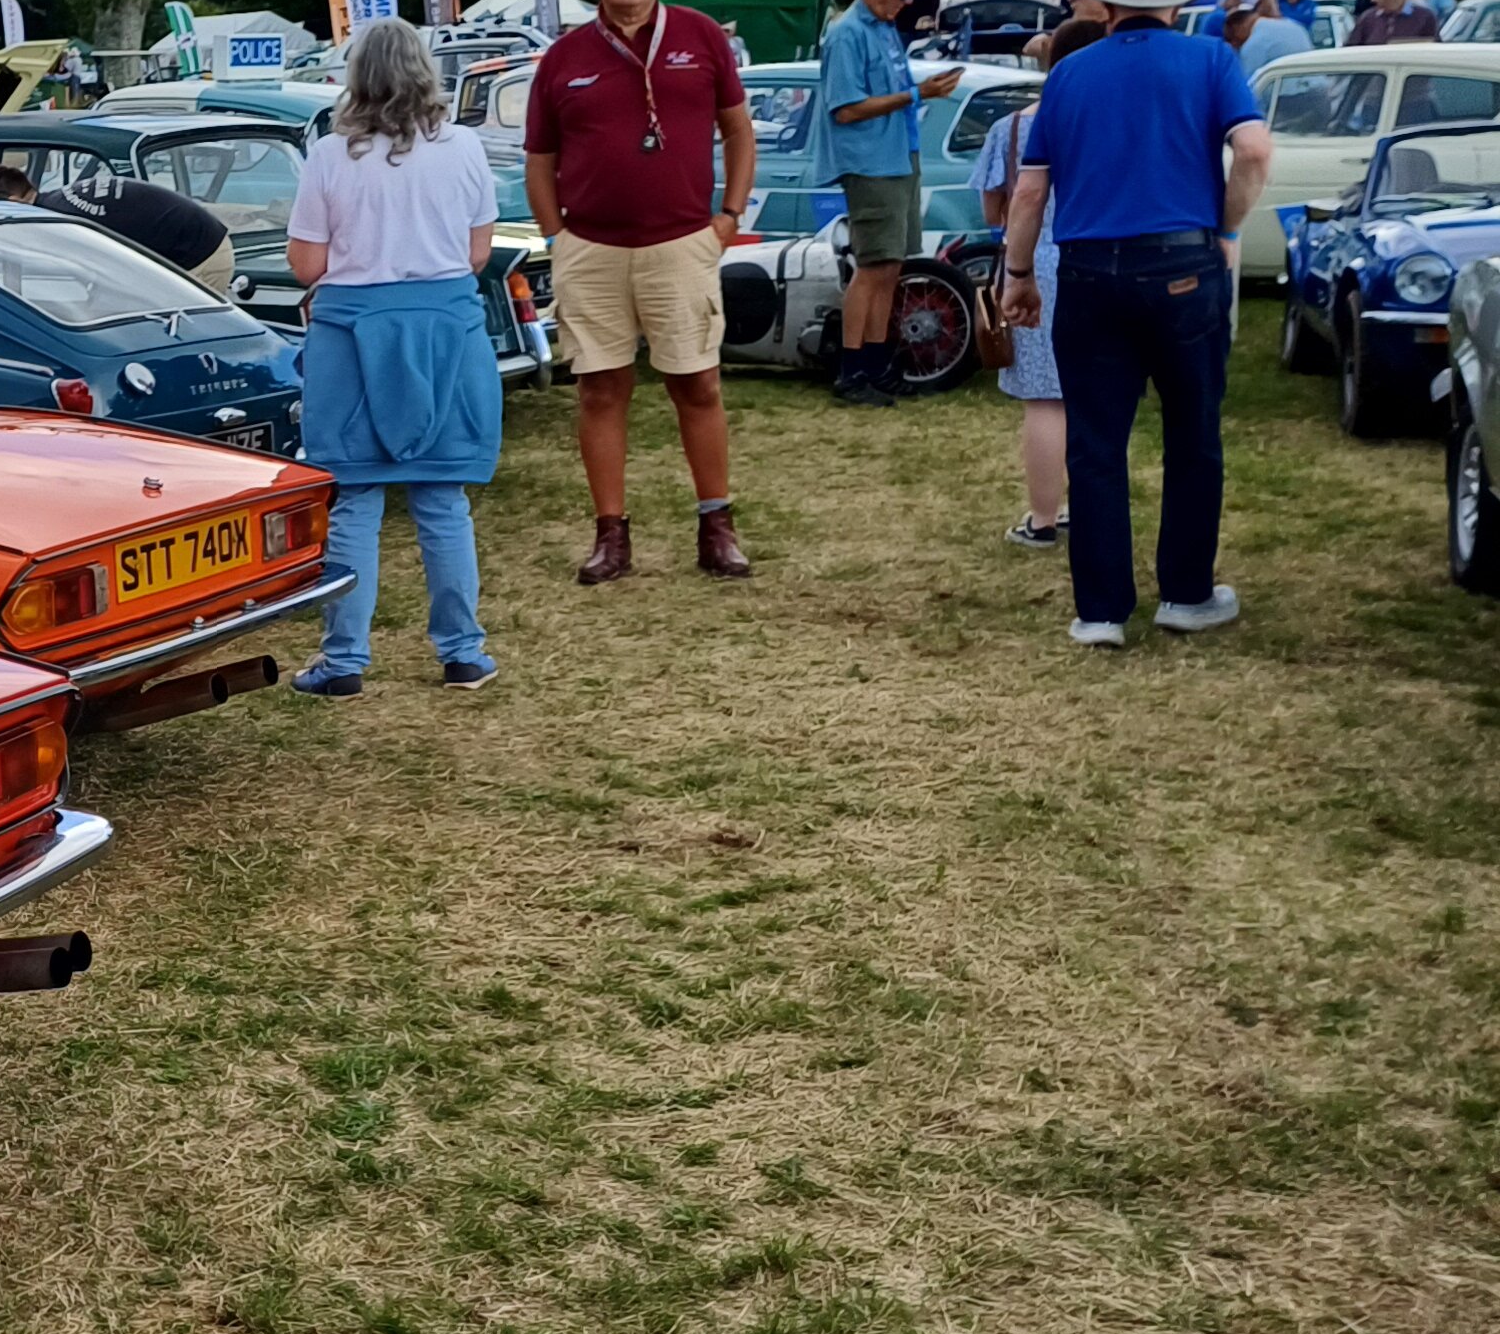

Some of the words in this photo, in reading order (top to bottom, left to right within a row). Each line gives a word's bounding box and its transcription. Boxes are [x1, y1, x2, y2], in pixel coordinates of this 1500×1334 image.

[231, 40, 281, 63] POLICE
[120, 536, 176, 592] STT
[183, 516, 250, 574] 740X
